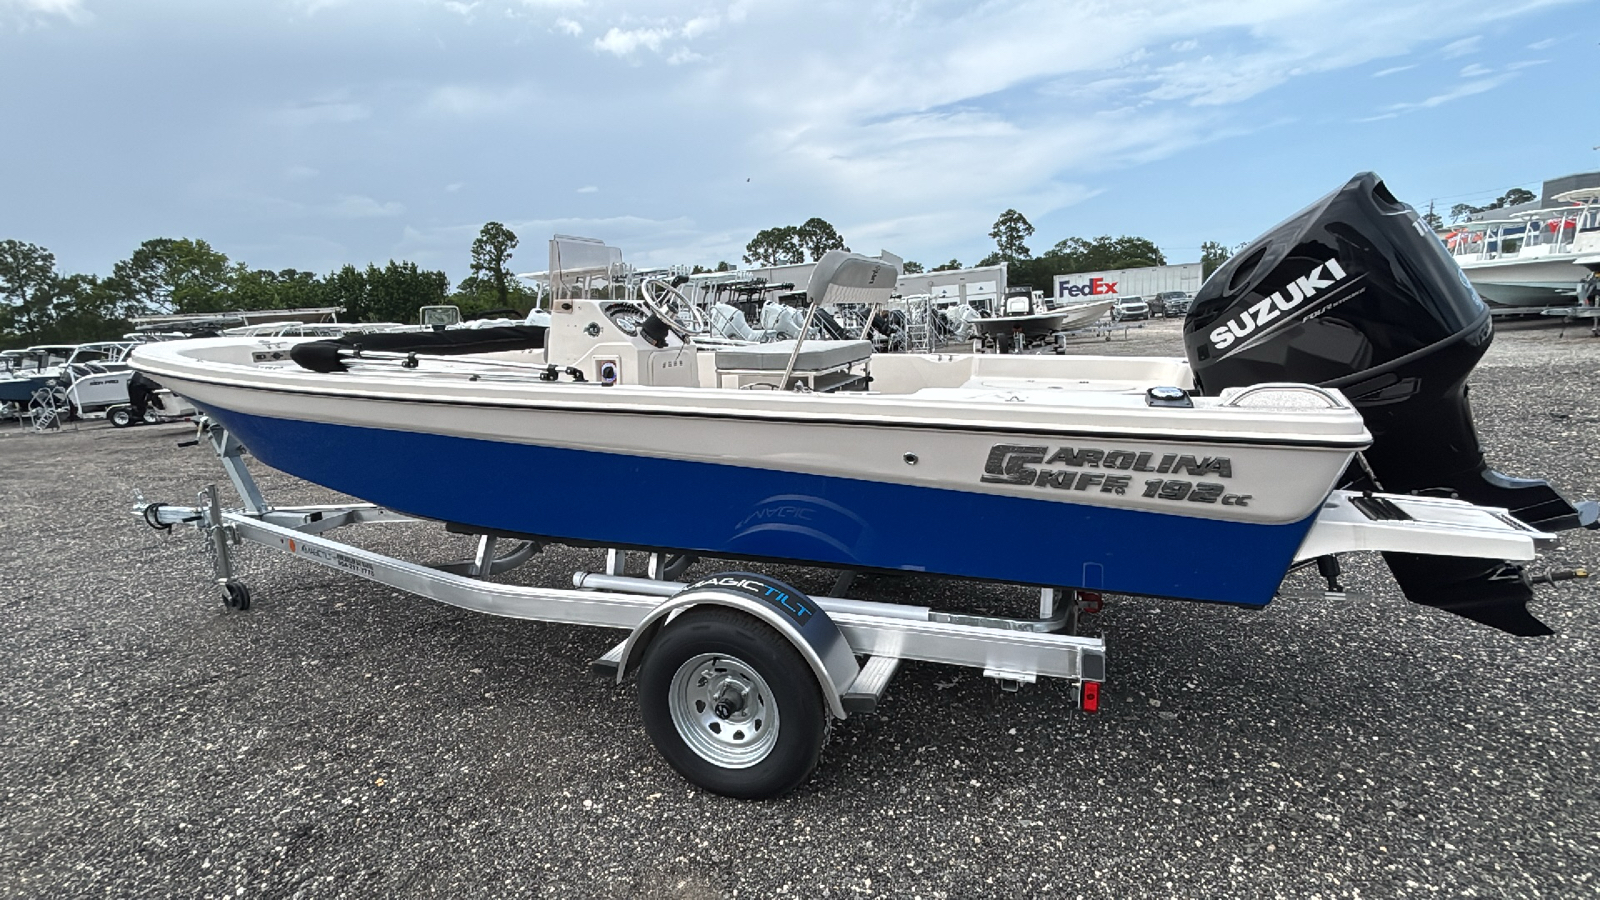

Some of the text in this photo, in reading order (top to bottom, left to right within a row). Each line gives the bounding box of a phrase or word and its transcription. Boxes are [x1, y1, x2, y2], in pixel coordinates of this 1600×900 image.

[1059, 277, 1118, 298] FedEx
[1209, 257, 1347, 349] SUZUKI
[980, 456, 1132, 493] SKIFF
[985, 443, 1232, 478] CAROLINA
